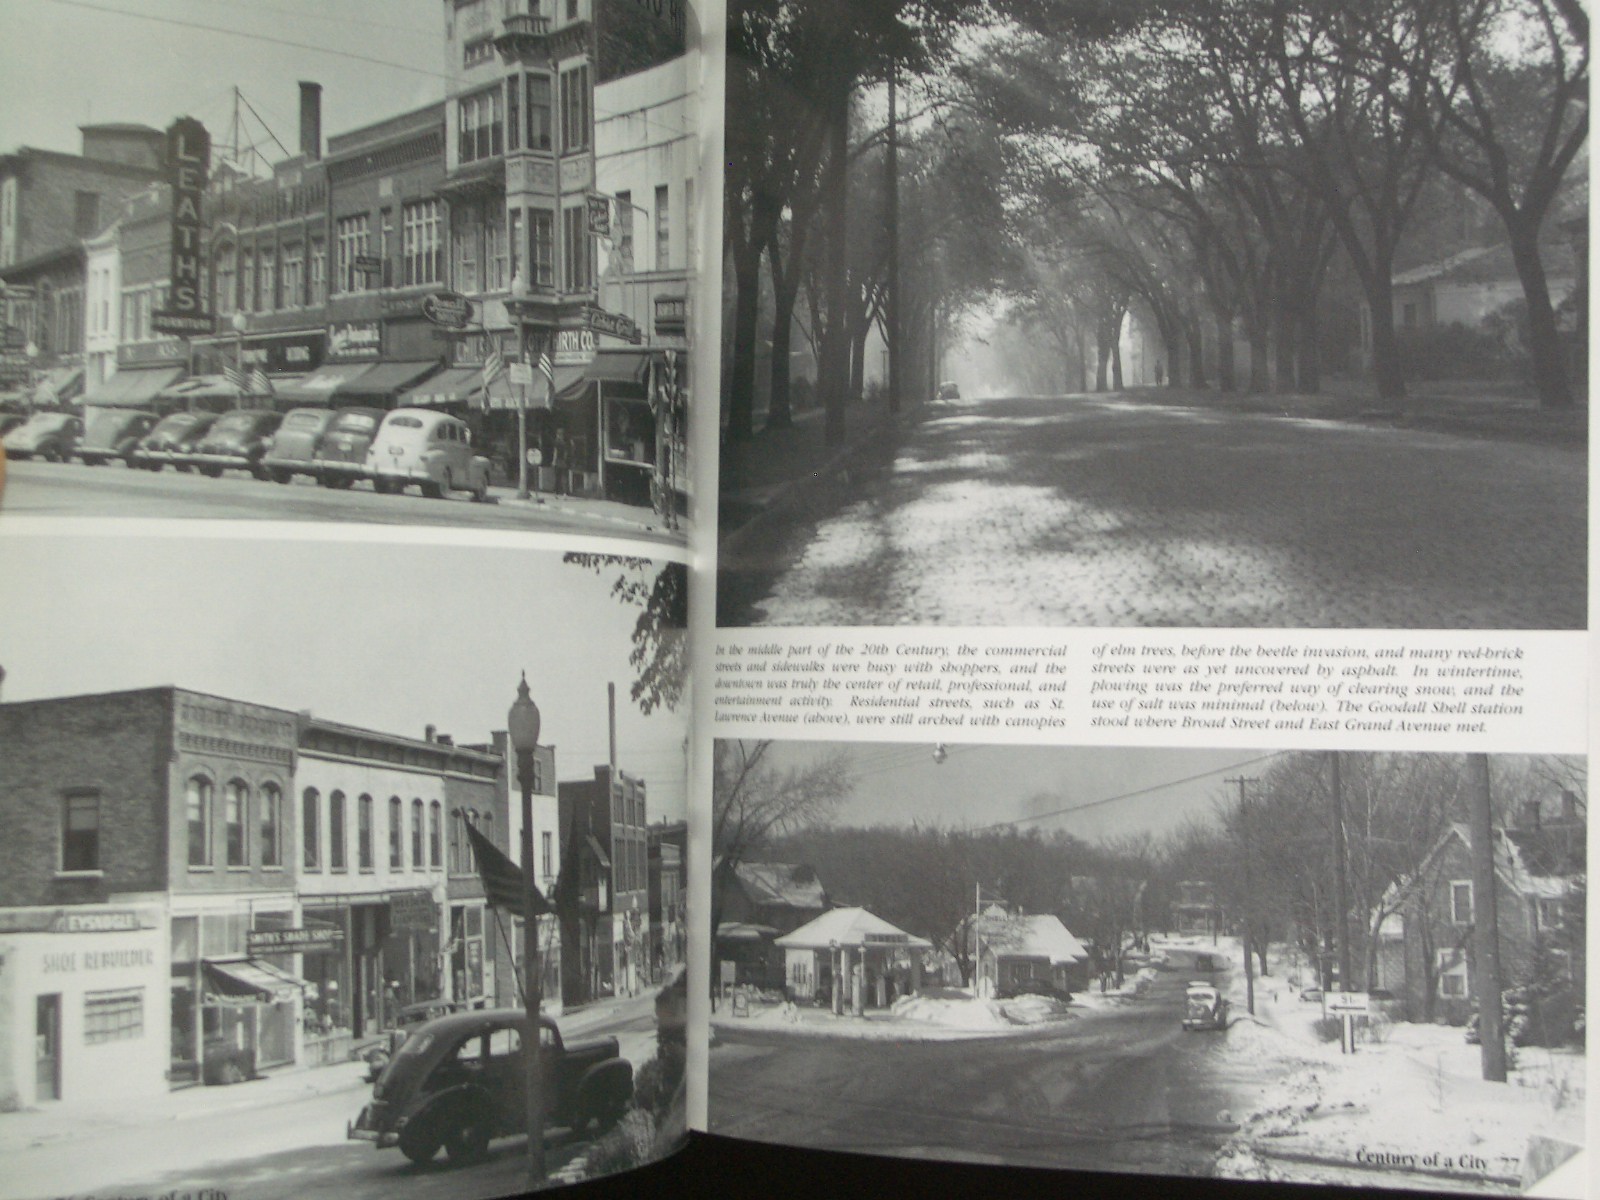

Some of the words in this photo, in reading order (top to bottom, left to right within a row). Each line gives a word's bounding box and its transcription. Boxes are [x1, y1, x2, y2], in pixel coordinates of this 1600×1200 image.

[746, 643, 784, 655] middle
[787, 644, 812, 657] part
[816, 644, 830, 658] of
[859, 643, 890, 655] 20th
[894, 645, 951, 656] Century,
[984, 645, 1067, 656] commercial
[1091, 644, 1107, 658] of
[1109, 644, 1137, 655] elm
[1140, 645, 1178, 655] trees,
[1180, 644, 1226, 658] before
[1229, 645, 1253, 656] the
[1255, 645, 1299, 656] beetle
[1302, 647, 1371, 657] invasion,
[1374, 647, 1405, 657] and
[1408, 649, 1453, 659] many
[1456, 647, 1524, 659] red-brick
[714, 661, 745, 672] streets
[745, 661, 768, 671] and
[770, 660, 826, 671] sidewalks
[831, 663, 861, 672] were
[866, 661, 897, 673] busy
[903, 661, 934, 672] with
[939, 662, 1003, 676] shoppers,
[1009, 662, 1038, 673] and
[1044, 662, 1067, 673] the
[1091, 662, 1136, 672] streets
[1142, 665, 1177, 673] were
[1182, 665, 1200, 673] as
[1205, 663, 1228, 674] yet
[1234, 663, 1310, 675] uncovered
[1316, 663, 1335, 676] by
[1340, 664, 1400, 678] asphalt.
[1436, 665, 1523, 677] wintertime,
[714, 677, 764, 689] downtown
[765, 679, 789, 688] was
[790, 678, 819, 690] truly
[822, 678, 842, 689] the
[844, 679, 884, 689] center
[886, 679, 901, 693] of
[905, 679, 944, 690] retail,
[947, 679, 1034, 693] professional,
[1037, 680, 1067, 691] and
[1091, 679, 1149, 694] plowing
[1154, 683, 1184, 691] was
[1188, 681, 1212, 691] the
[1217, 681, 1284, 695] preferred
[1289, 684, 1321, 693] way
[1326, 682, 1343, 697] of
[1347, 682, 1409, 697] clearing
[1414, 685, 1458, 695] snow,
[1463, 684, 1495, 695] and
[1500, 684, 1524, 695] the
[713, 695, 783, 705] entertainment
[788, 695, 837, 707] activity.
[849, 695, 921, 707] Residential
[928, 697, 974, 707] streets,
[982, 697, 1016, 708] such
[1023, 700, 1041, 709] as
[1050, 698, 1063, 709] St.
[1091, 699, 1116, 708] use
[1118, 698, 1134, 712] of
[1137, 697, 1164, 709] salt
[1167, 701, 1198, 709] was
[1200, 699, 1265, 710] minimal
[1268, 699, 1329, 711] (below).
[1336, 699, 1364, 712] The
[1366, 701, 1428, 712] Goodall
[1430, 701, 1467, 713] Shell
[1470, 703, 1524, 714] station
[713, 710, 758, 722] Lawrence
[759, 712, 800, 722] Avenue
[802, 712, 852, 724] (above),
[855, 715, 886, 724] were
[889, 713, 914, 724] still
[917, 714, 965, 725] arched
[969, 714, 1001, 725] with
[1004, 715, 1066, 729] canopies
[1090, 715, 1130, 726] stood
[1133, 716, 1178, 727] where
[1181, 716, 1226, 728] Broad
[1229, 717, 1271, 728] Street
[1274, 718, 1305, 729] and
[1308, 717, 1341, 729] East
[1343, 719, 1393, 730] Grand
[1395, 720, 1452, 731] Avenue
[1455, 721, 1485, 732] met.
[43, 953, 76, 973] SHOE
[1356, 1150, 1415, 1167] Century
[1422, 1153, 1439, 1167] of
[1443, 1158, 1453, 1168] a
[1459, 1154, 1487, 1170] City
